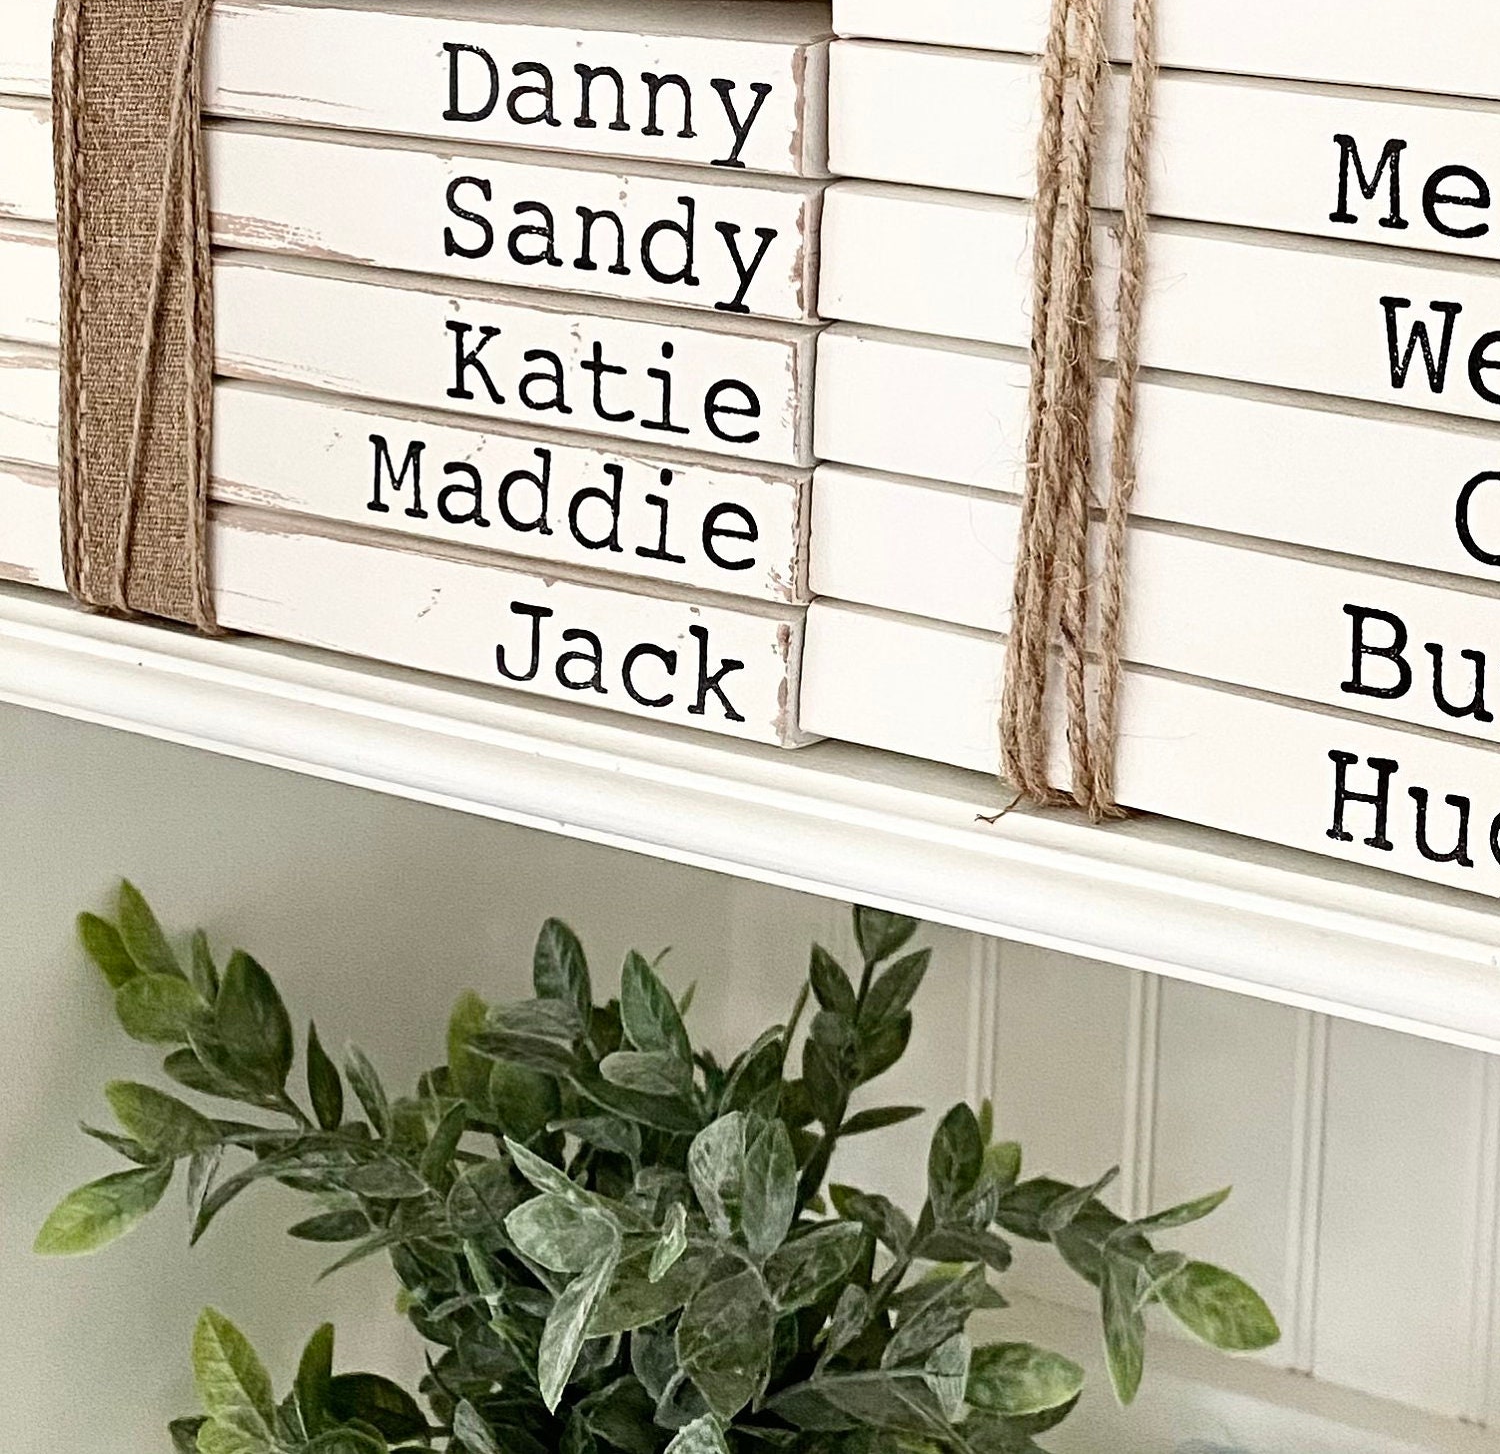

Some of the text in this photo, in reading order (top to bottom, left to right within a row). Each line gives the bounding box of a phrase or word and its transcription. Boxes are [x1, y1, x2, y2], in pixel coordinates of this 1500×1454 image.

[441, 41, 774, 170] Danny
[442, 174, 779, 315] Sandy
[444, 319, 762, 445] Katie
[365, 432, 760, 572] Maddie
[495, 599, 747, 724] Jack
